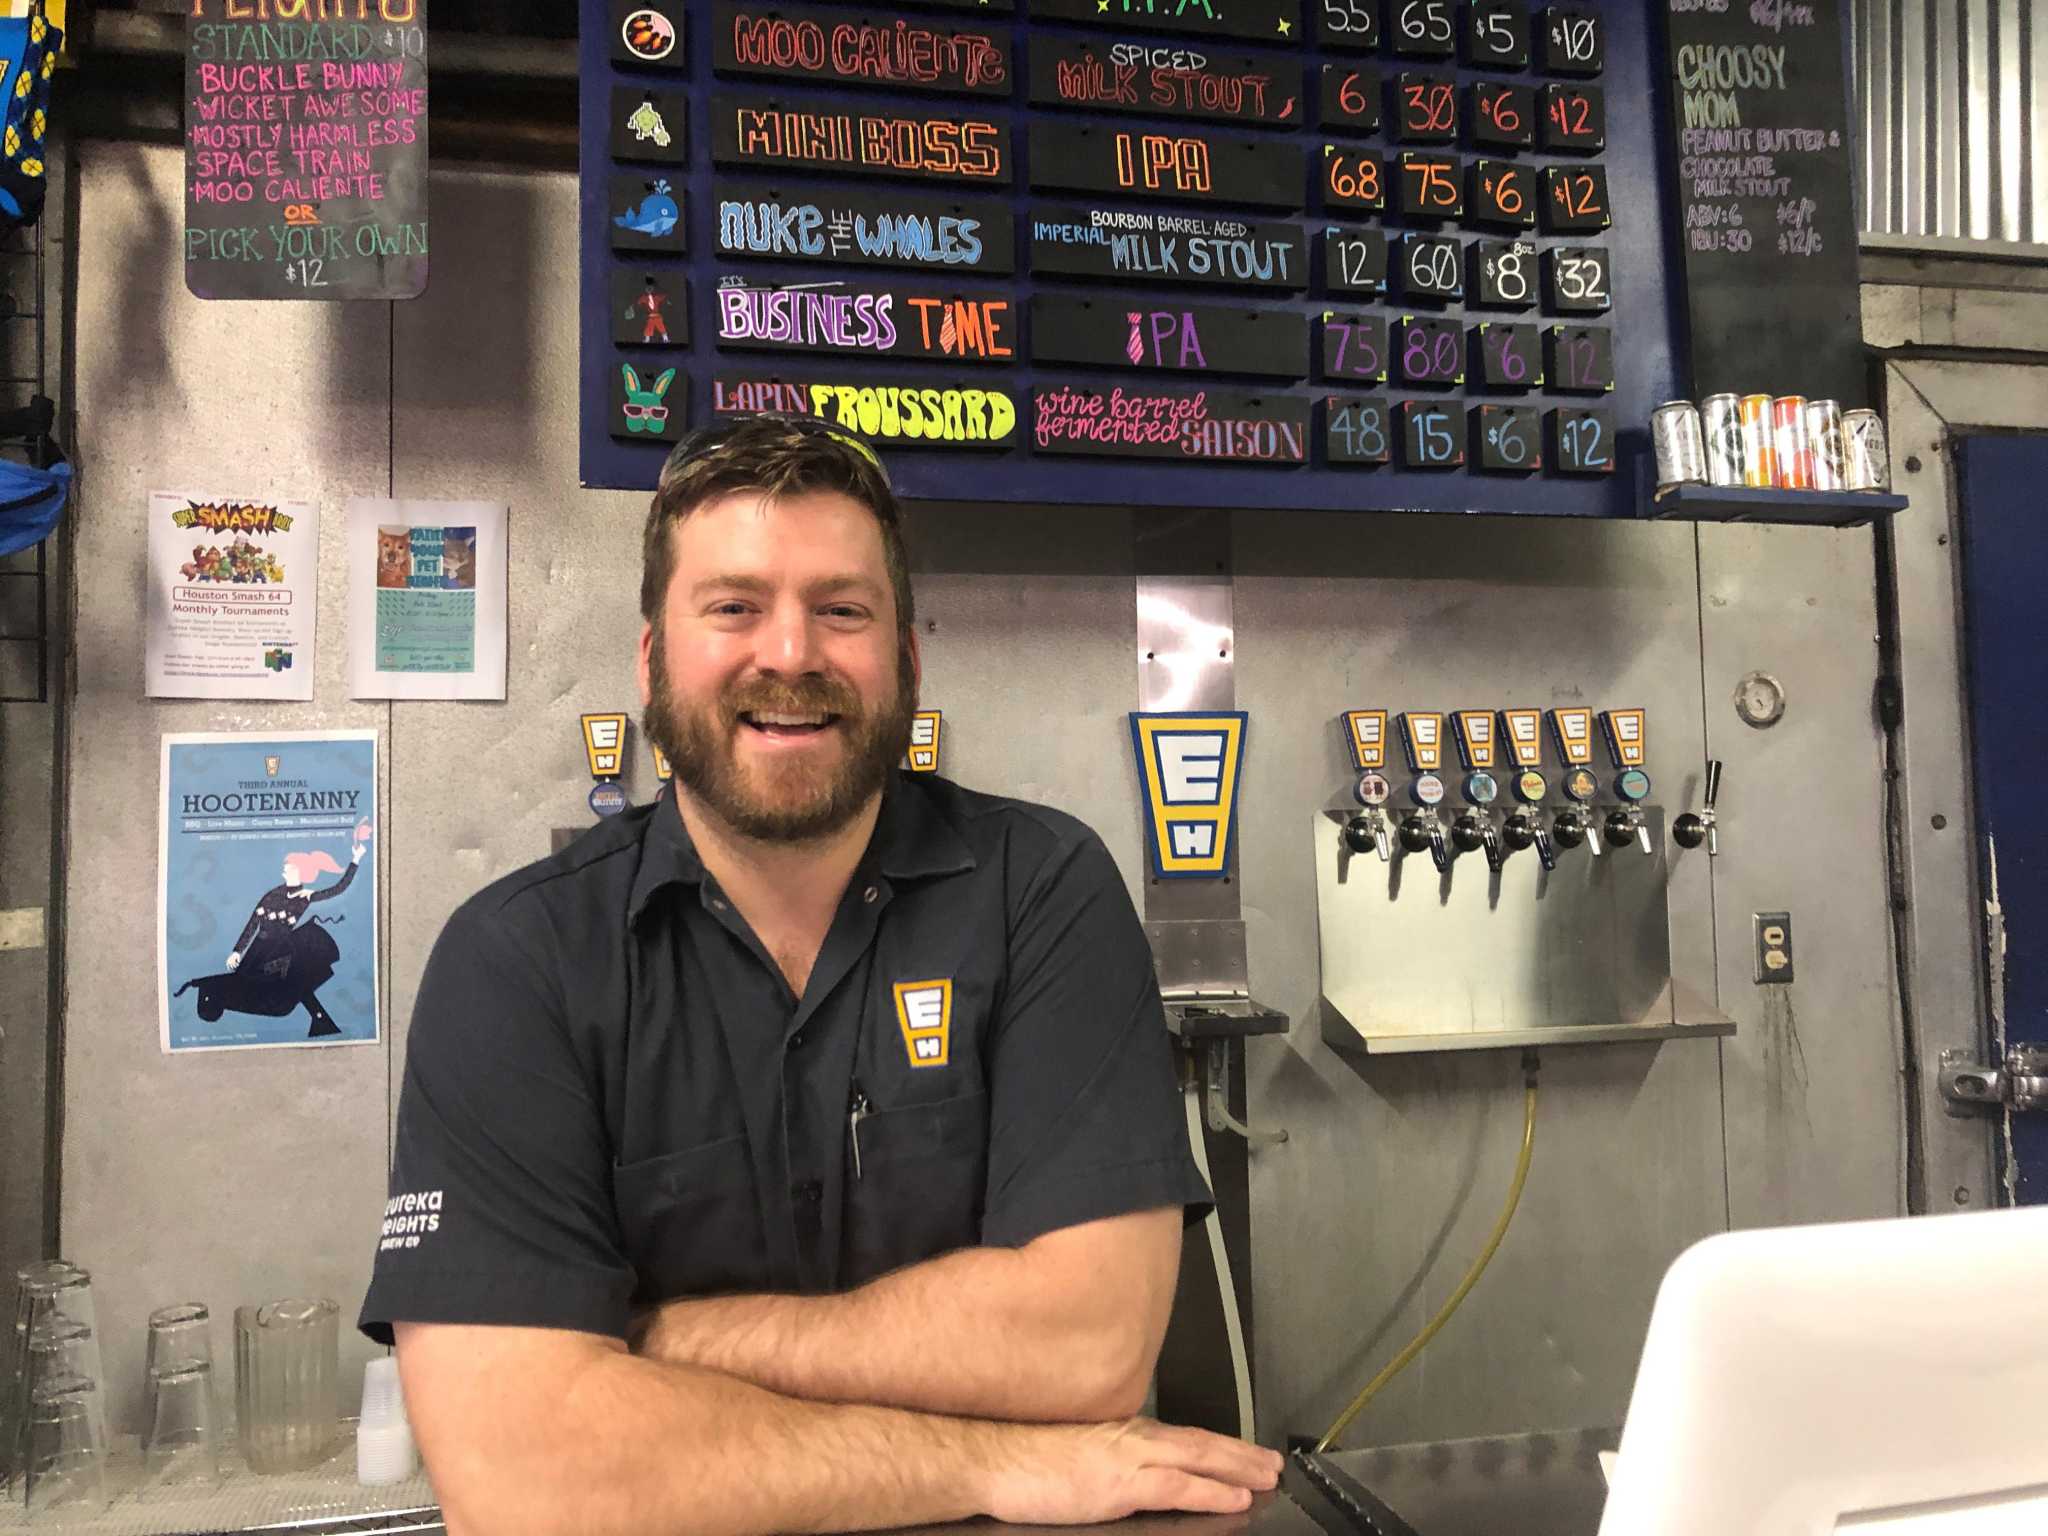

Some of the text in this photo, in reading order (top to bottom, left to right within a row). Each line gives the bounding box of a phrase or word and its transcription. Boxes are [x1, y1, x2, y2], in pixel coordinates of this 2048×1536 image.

[1401, 0, 1451, 41] 65
[1476, 14, 1514, 53] $5
[1551, 17, 1595, 61] $10
[192, 23, 424, 60] STANDARD $10
[735, 14, 824, 70] MOO
[1109, 43, 1207, 71] SPICED
[201, 62, 404, 93] BUCKLE BUNNY
[1677, 43, 1786, 90] CHOOSY
[198, 95, 296, 121] WICKET
[1150, 68, 1271, 117] STOUT
[1339, 73, 1366, 114] 6
[1404, 84, 1455, 131] 30
[1481, 91, 1520, 131] $6
[1683, 90, 1741, 129] MOM
[192, 119, 417, 149] MOSTLY HARMLESS
[1551, 97, 1594, 136] $12
[737, 109, 1000, 176] MINI BOSS
[1681, 127, 1753, 155] PEANUT
[1756, 128, 1826, 153] BUTTER
[196, 148, 371, 178] SPACE TRAIN
[1680, 156, 1776, 178] CHOCOLATE
[194, 173, 385, 203] MOO CALIENTE
[1404, 163, 1457, 206] 75
[1484, 171, 1522, 214] $6
[1554, 175, 1601, 218] $12
[1694, 177, 1792, 198] MILK STOUT
[284, 204, 318, 221] OR
[1090, 210, 1153, 230] BOURBON
[186, 222, 428, 262] PICK YOUR OWN
[827, 208, 853, 257] THE
[855, 213, 983, 265] WHALES
[1034, 221, 1112, 246] IMPERIAL
[285, 258, 328, 288] $12
[1110, 233, 1293, 281] MILK STOUT
[1338, 241, 1374, 286] 12
[1411, 243, 1458, 291] 60
[1486, 253, 1527, 300] $8
[1555, 259, 1606, 299] $32
[718, 288, 1013, 357] BUSINESS TIME
[1403, 327, 1459, 379] 80
[713, 380, 1017, 441] LAPIN FROUSSARD
[1035, 386, 1209, 420] wine barrel
[1035, 410, 1304, 459] fermented SAISON
[1412, 412, 1453, 462] 15
[1488, 416, 1526, 464] $6
[1562, 418, 1608, 467] $12
[198, 505, 270, 530] SMASH
[172, 604, 289, 616] Monthly Tournaments
[183, 589, 281, 601] Houston Smash 64
[270, 779, 309, 788] ANNUAL
[1157, 735, 1223, 801] E
[182, 790, 360, 813] HOOTENANNY
[1173, 825, 1212, 855] H
